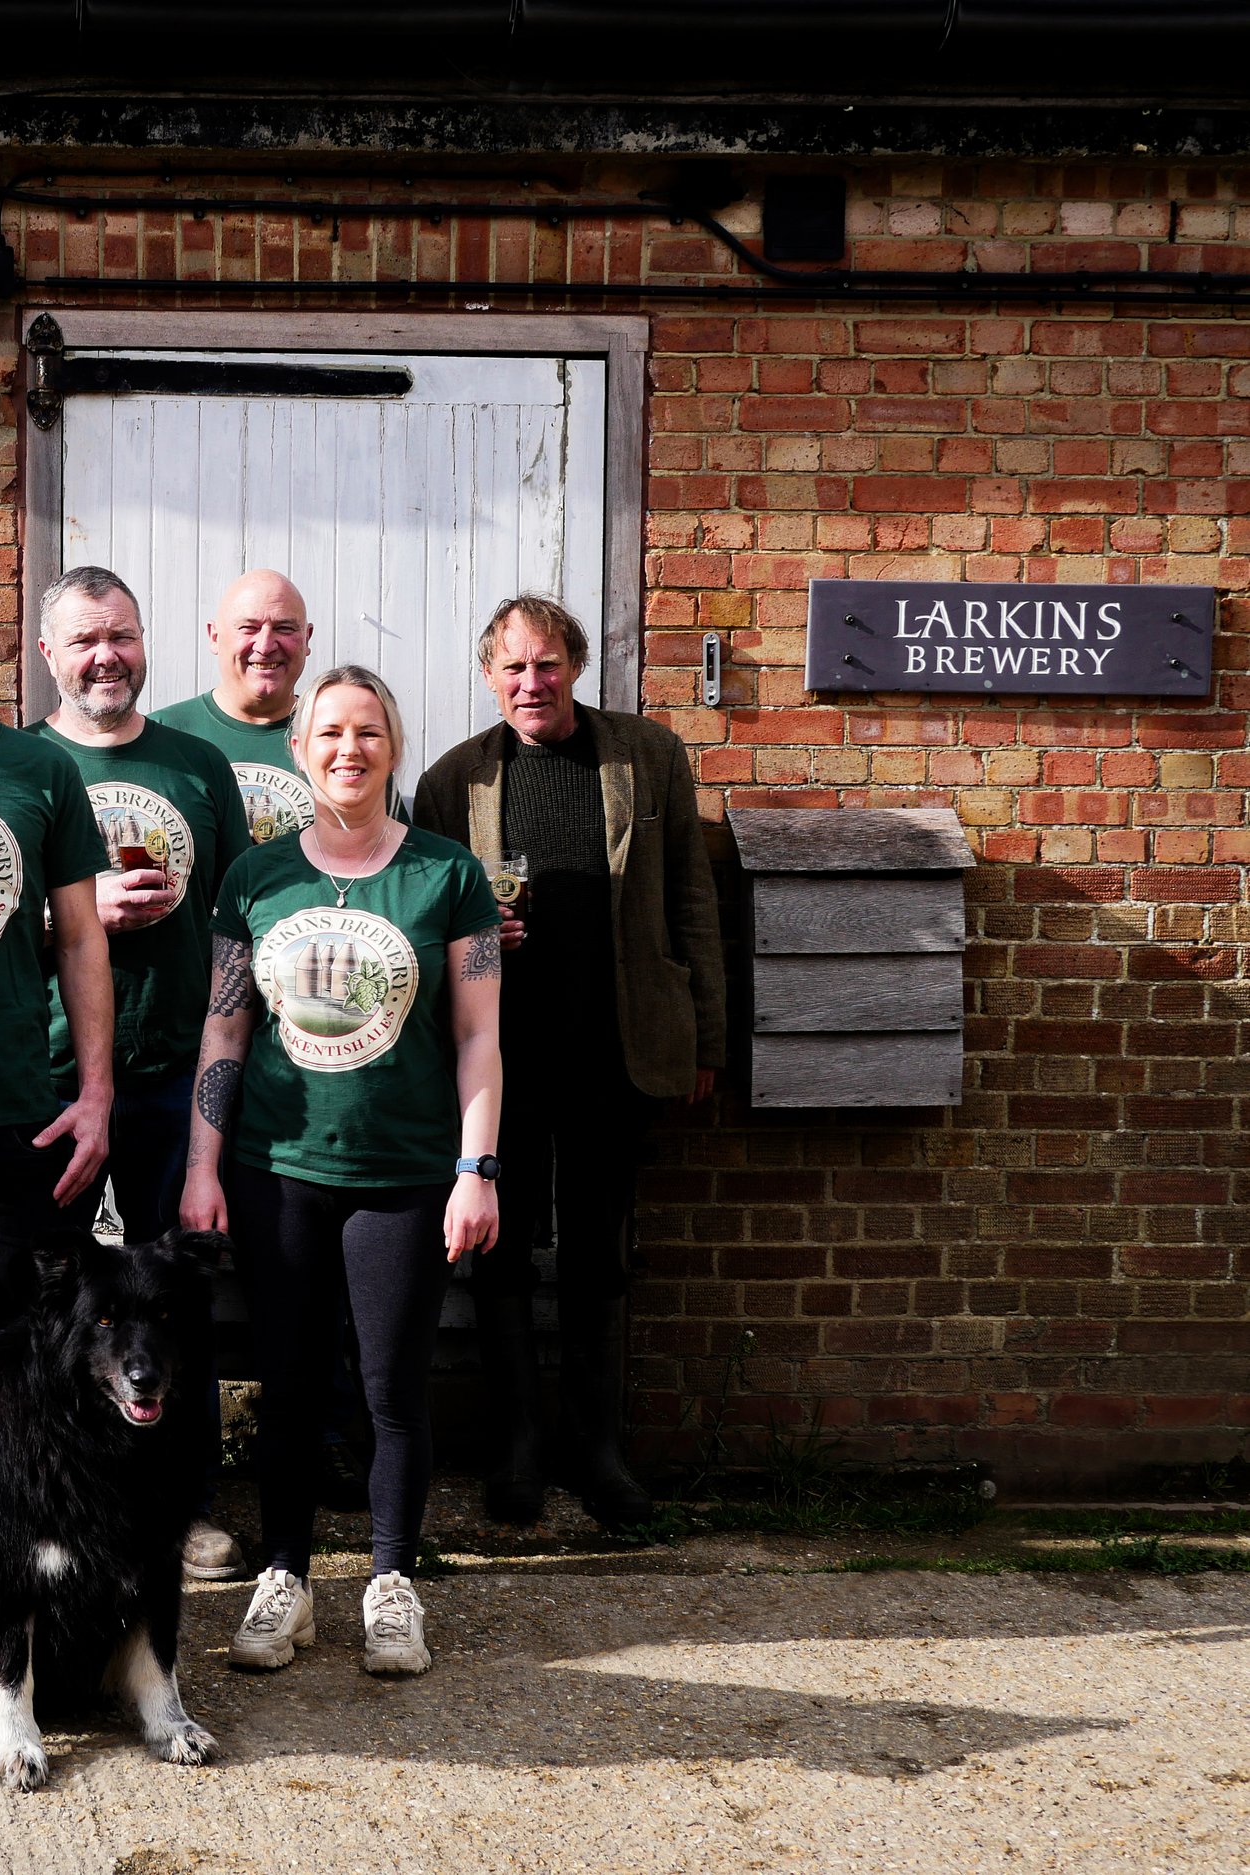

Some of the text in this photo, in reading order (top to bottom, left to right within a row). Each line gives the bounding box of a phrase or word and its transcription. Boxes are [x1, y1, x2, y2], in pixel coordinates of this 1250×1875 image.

[894, 599, 1122, 641] LARKINS
[903, 644, 1115, 676] BREWERY
[115, 790, 186, 857] BREWERY
[255, 771, 315, 826] BREWER
[261, 915, 408, 996] LARKINS BREWERY
[290, 1009, 395, 1057] KENTISH ALES
